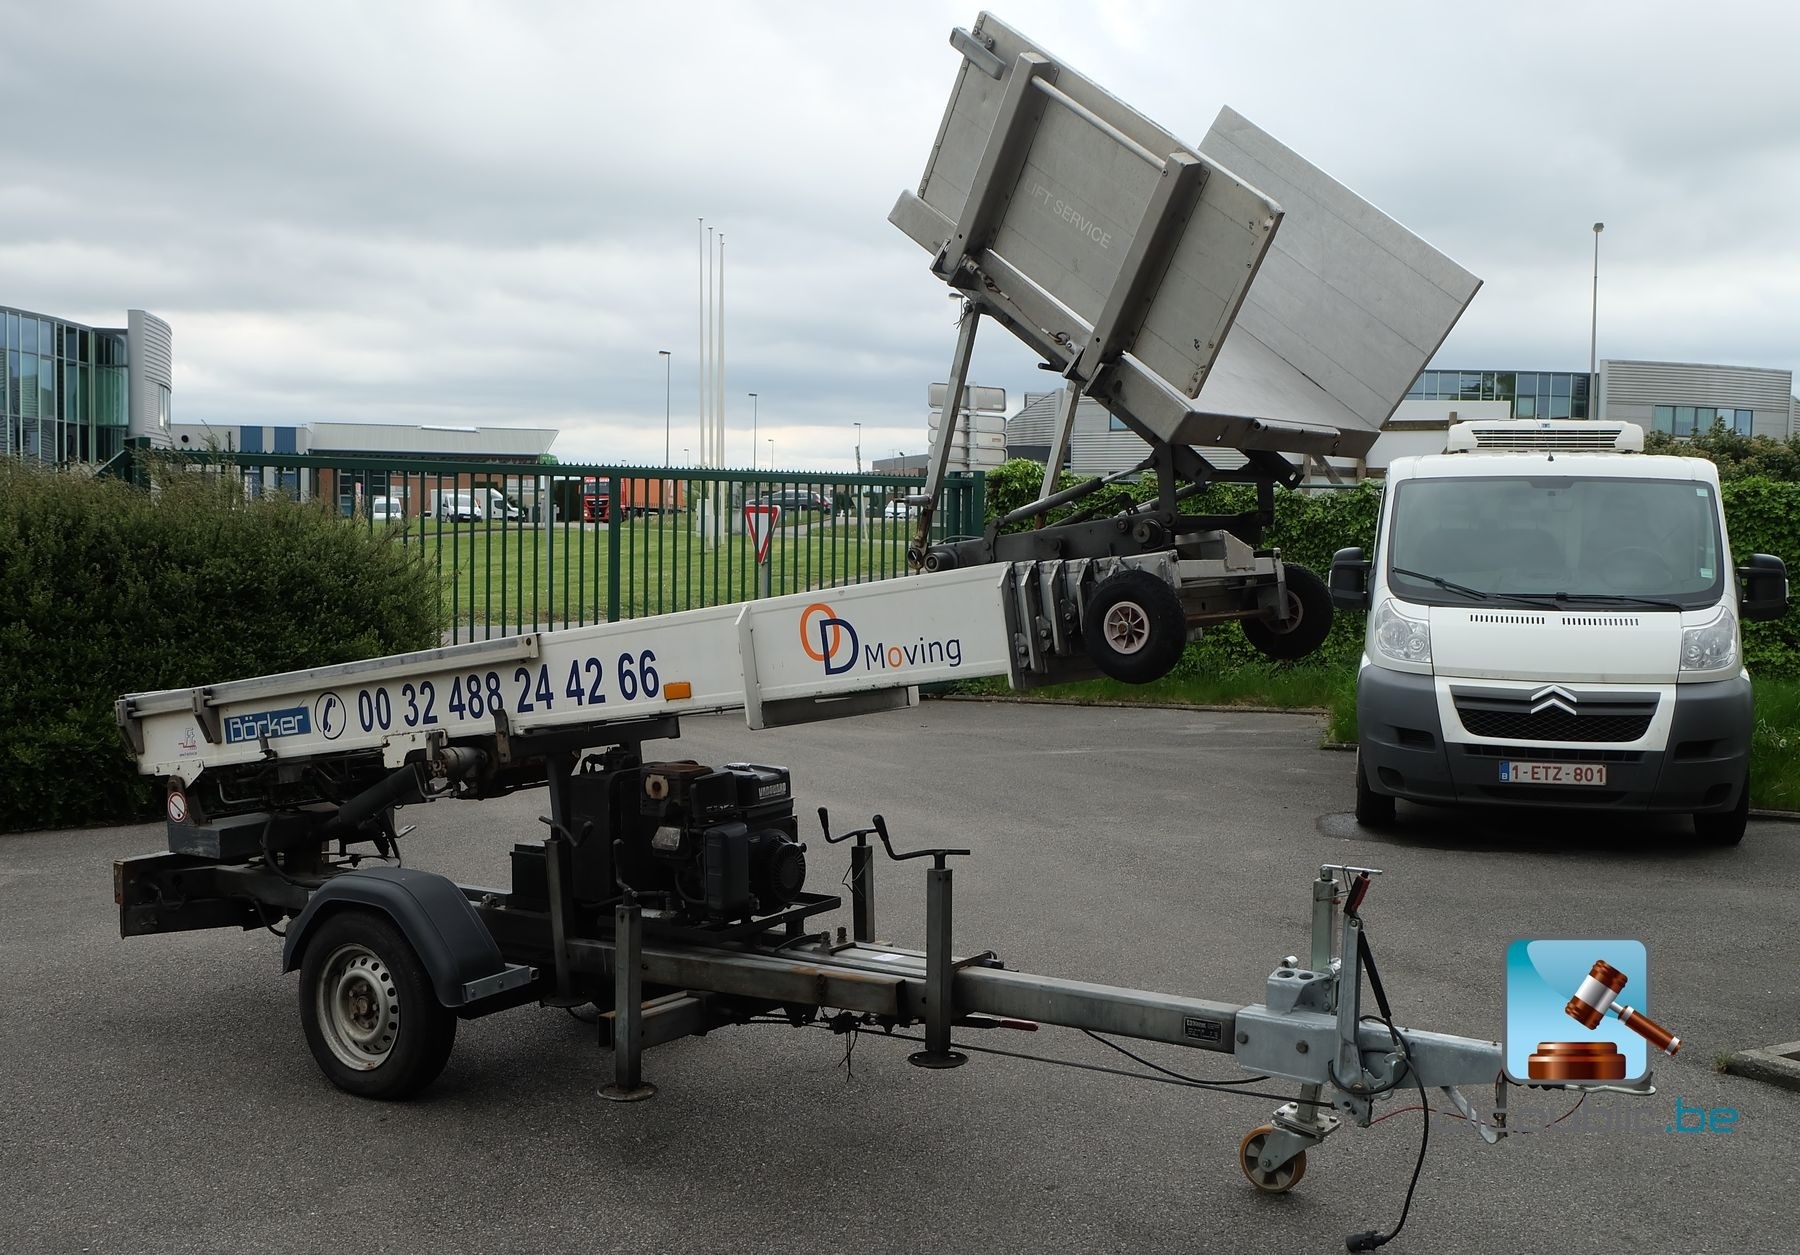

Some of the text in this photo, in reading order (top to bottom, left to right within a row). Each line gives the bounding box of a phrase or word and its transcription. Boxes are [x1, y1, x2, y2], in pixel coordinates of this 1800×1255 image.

[1024, 178, 1112, 249] LIFT SERVICE
[865, 637, 962, 670] Moving
[358, 649, 660, 733] 00 32 488 24 42 66
[229, 713, 304, 742] Böcker
[1512, 765, 1603, 783] 1-ETZ-801
